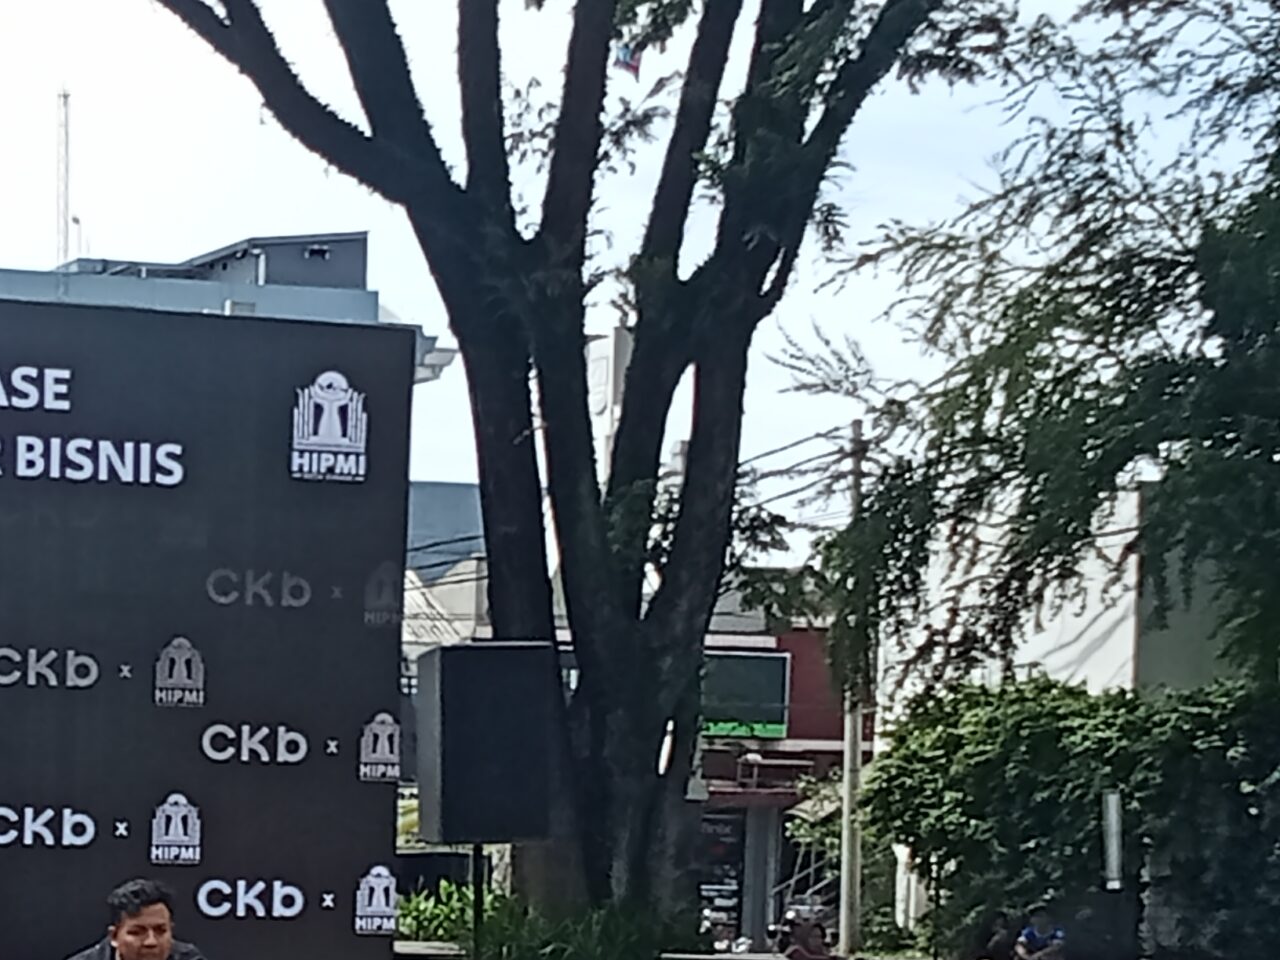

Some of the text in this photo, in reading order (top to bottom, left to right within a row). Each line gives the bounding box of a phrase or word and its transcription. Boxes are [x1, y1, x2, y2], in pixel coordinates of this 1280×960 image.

[16, 435, 184, 485] BISNIS
[290, 450, 367, 477] HIPMI
[154, 687, 205, 703] HIPMI
[201, 724, 308, 763] CKb
[360, 764, 400, 777] HIPM
[151, 844, 200, 862] HIPMI
[197, 879, 304, 918] CKb
[355, 917, 396, 930] HIPM
